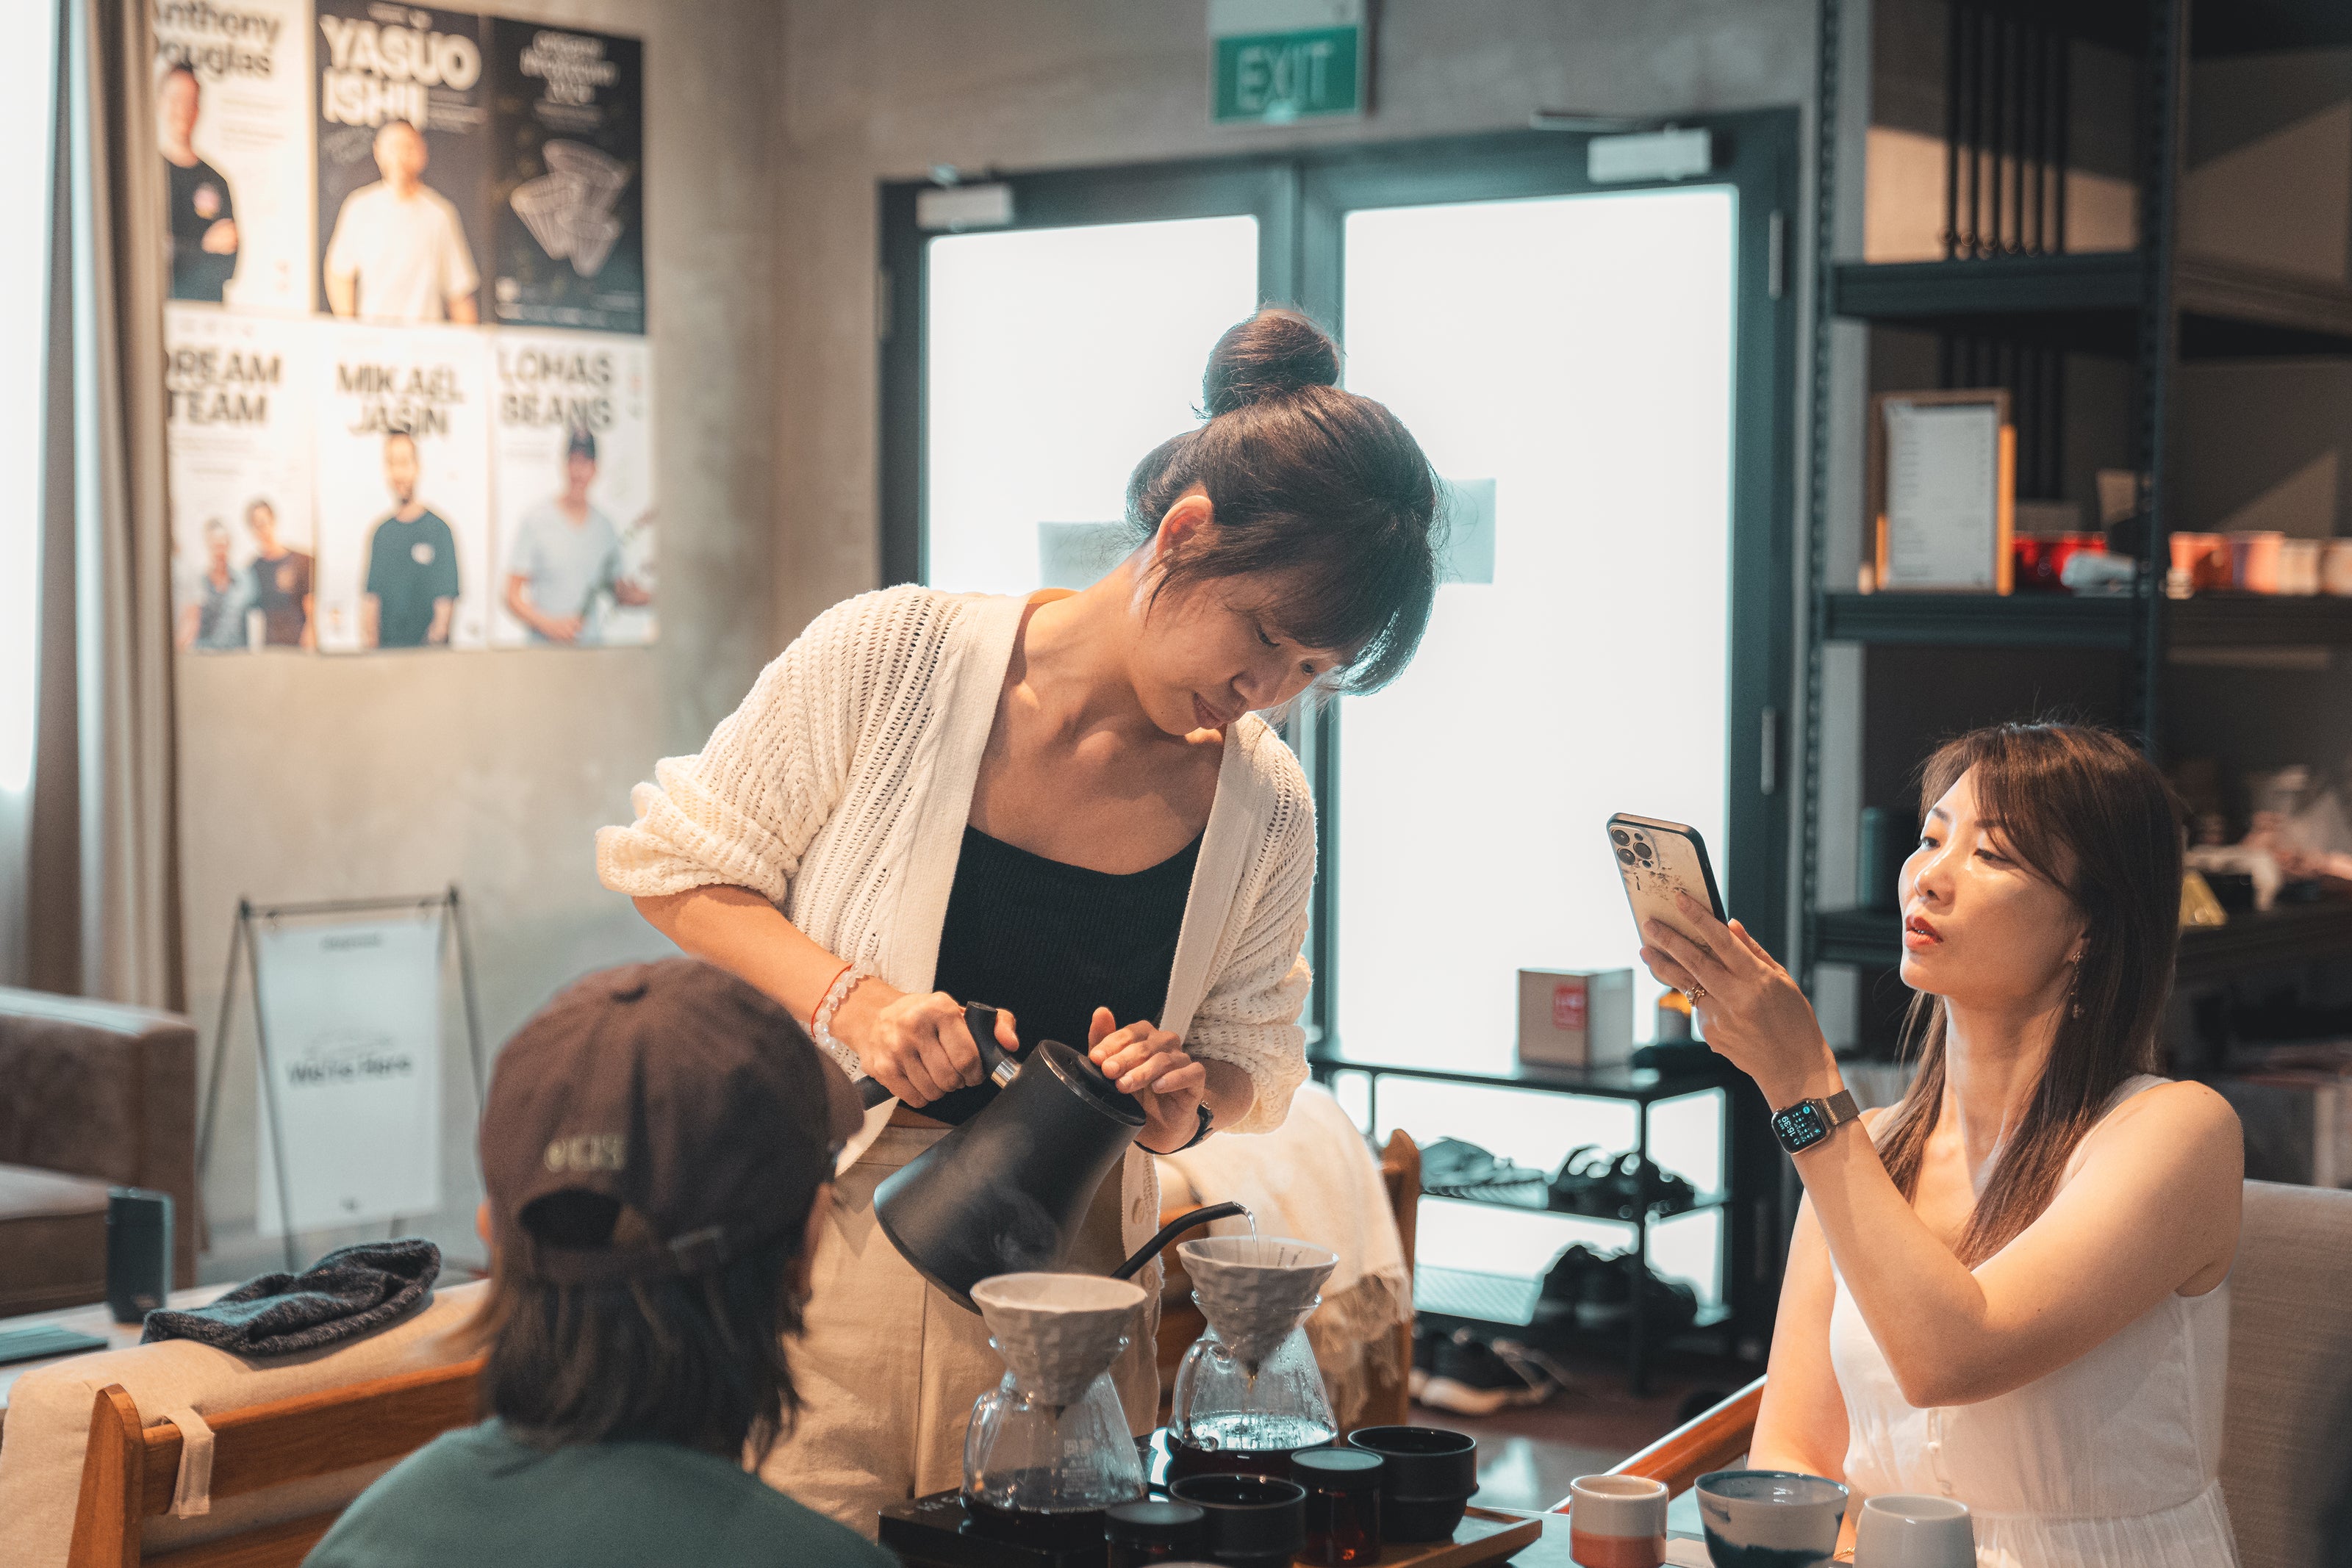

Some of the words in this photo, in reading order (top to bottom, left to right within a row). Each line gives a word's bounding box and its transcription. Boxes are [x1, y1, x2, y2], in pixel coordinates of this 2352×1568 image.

[152, 1, 280, 48] nthony
[319, 14, 481, 90] YASUO
[322, 66, 428, 129] ISHII
[1236, 42, 1332, 110] EXIT
[337, 362, 466, 404] MIKAEL
[498, 347, 612, 386] LOHAS
[1782, 1116, 1796, 1137] 15:39
